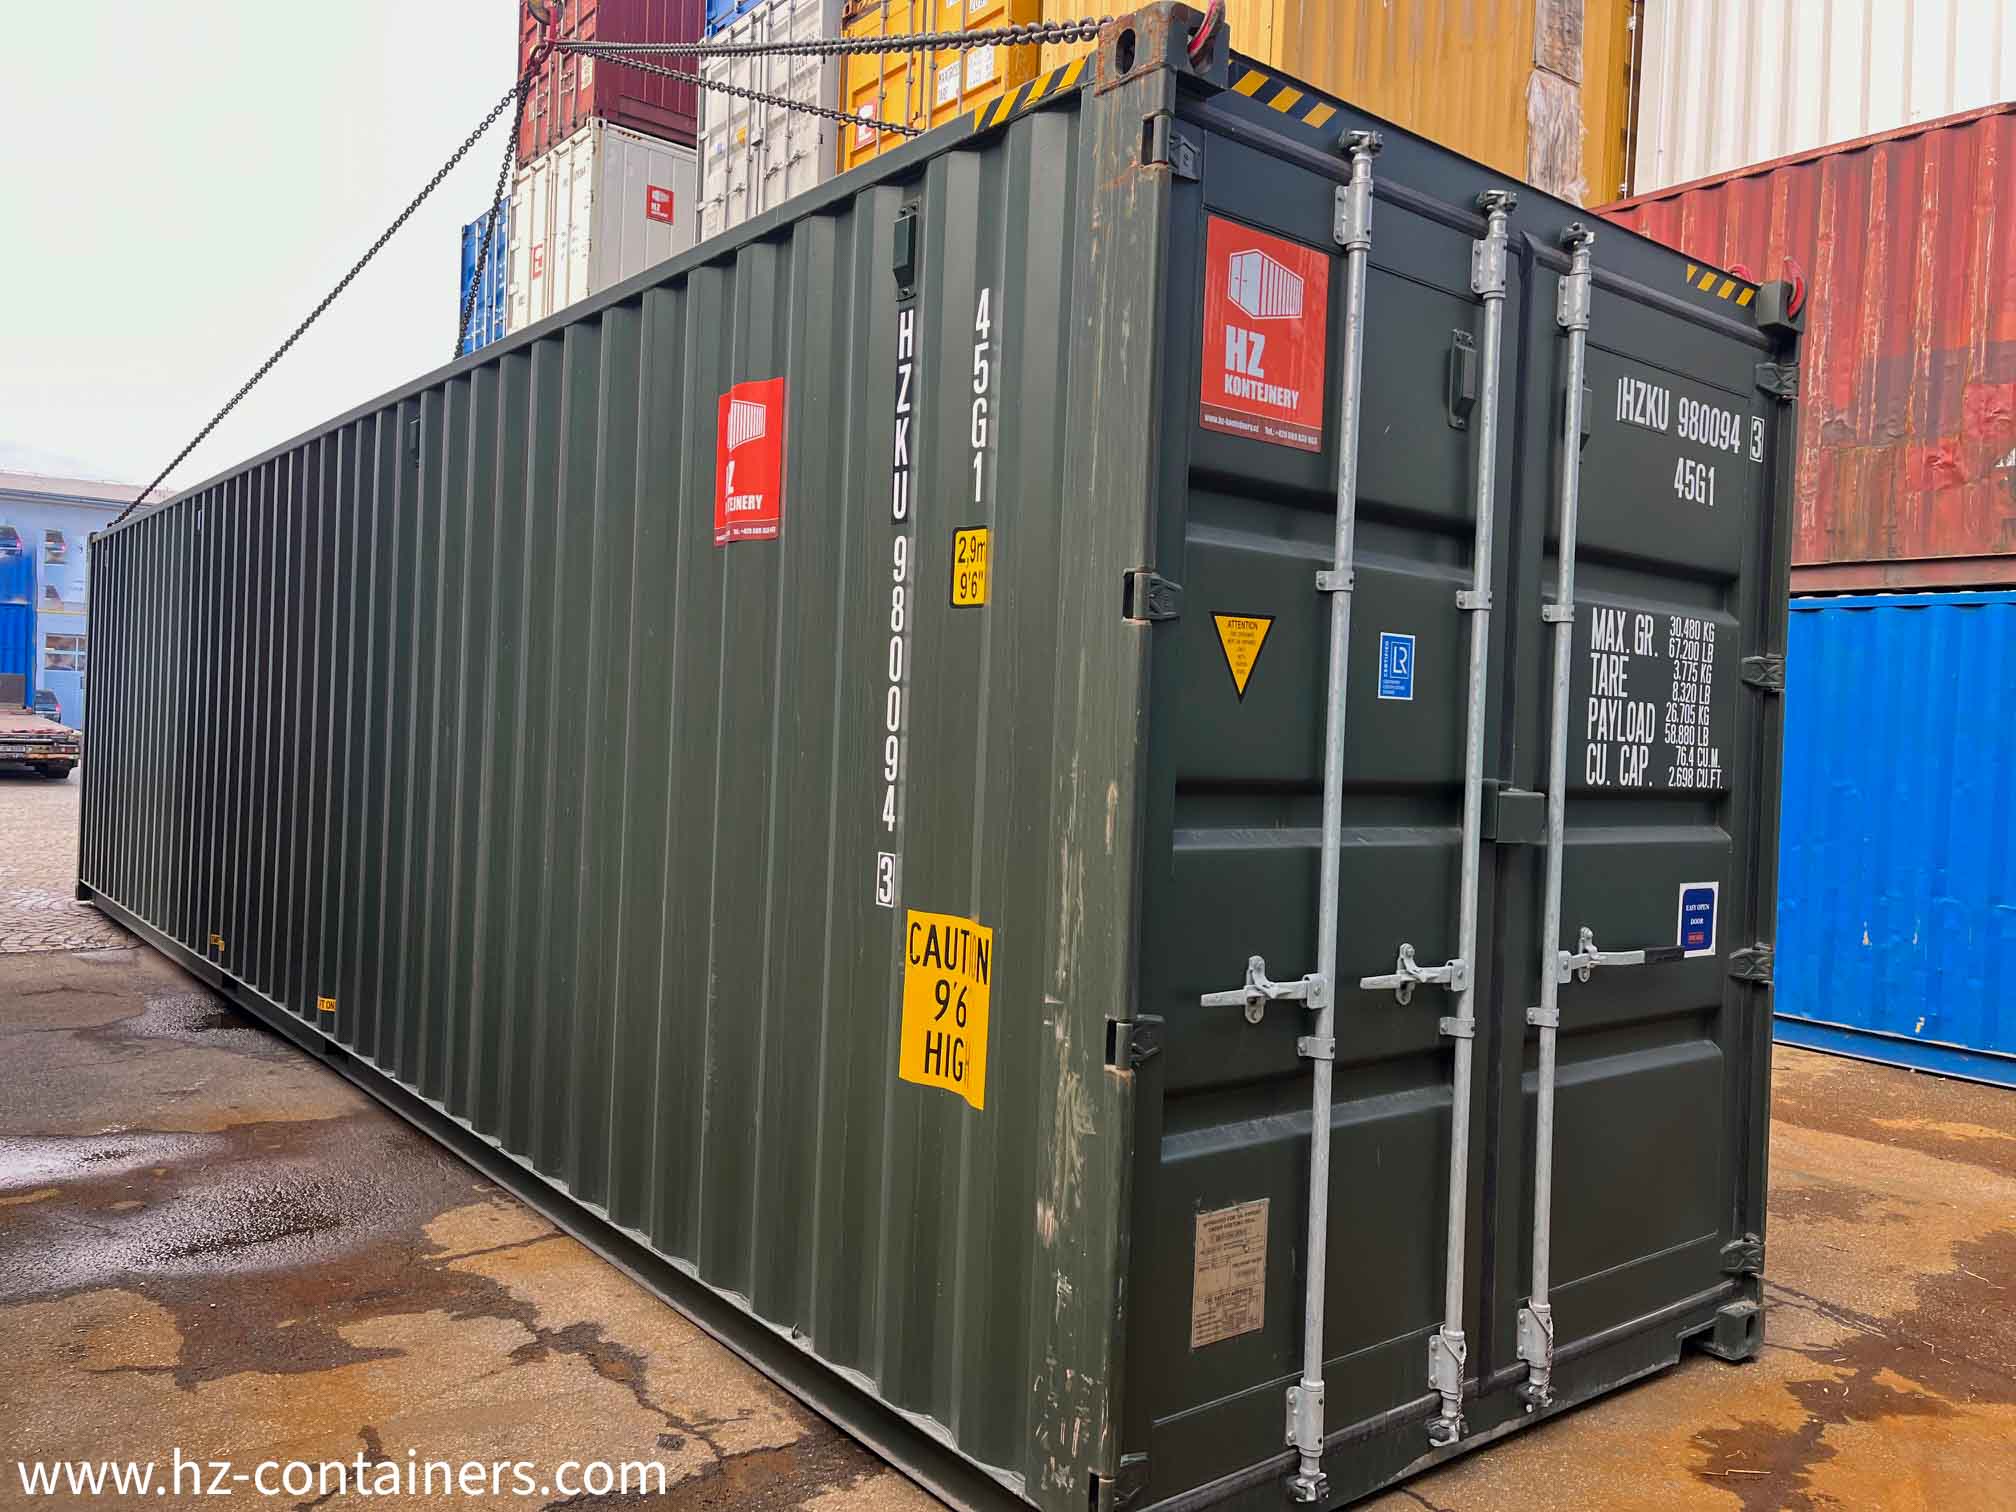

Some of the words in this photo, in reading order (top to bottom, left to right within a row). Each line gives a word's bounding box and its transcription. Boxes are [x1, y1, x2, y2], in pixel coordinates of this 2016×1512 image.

[1224, 324, 1266, 379] HZ
[971, 287, 991, 503] 45G1
[1224, 373, 1300, 410] KONTEJNERY
[893, 309, 914, 520] HZKU
[1677, 397, 1741, 454] 980094
[1751, 420, 1764, 459] 3
[1673, 457, 1716, 507] 45G1
[960, 571, 984, 600] 9'6"
[1590, 606, 1631, 654] MAX.
[1634, 613, 1659, 657] GR.
[1669, 615, 1701, 641] 30.480
[1702, 620, 1715, 643] KG
[1393, 646, 1408, 674] LR
[1668, 637, 1700, 661] 67.200
[1701, 642, 1714, 664] LB
[882, 534, 908, 832] 980094
[1590, 652, 1630, 698] TARE
[1672, 681, 1697, 703] 8.320
[1699, 684, 1711, 705] LB
[1673, 660, 1698, 683] 3.775
[1700, 663, 1712, 685] KG
[1586, 696, 1656, 744] PAYLOAD
[1665, 701, 1696, 725] 26.705
[1697, 705, 1710, 726] KG
[1664, 723, 1695, 746] 58.880
[1697, 726, 1709, 747] LB
[1585, 742, 1611, 786] CU.
[1619, 744, 1653, 787] CAP.
[1675, 745, 1694, 768] 76.4
[1697, 747, 1721, 768] CU.M.
[1667, 766, 1694, 788] 2.698
[1696, 767, 1723, 789] CU.FT.
[878, 855, 894, 903] 3
